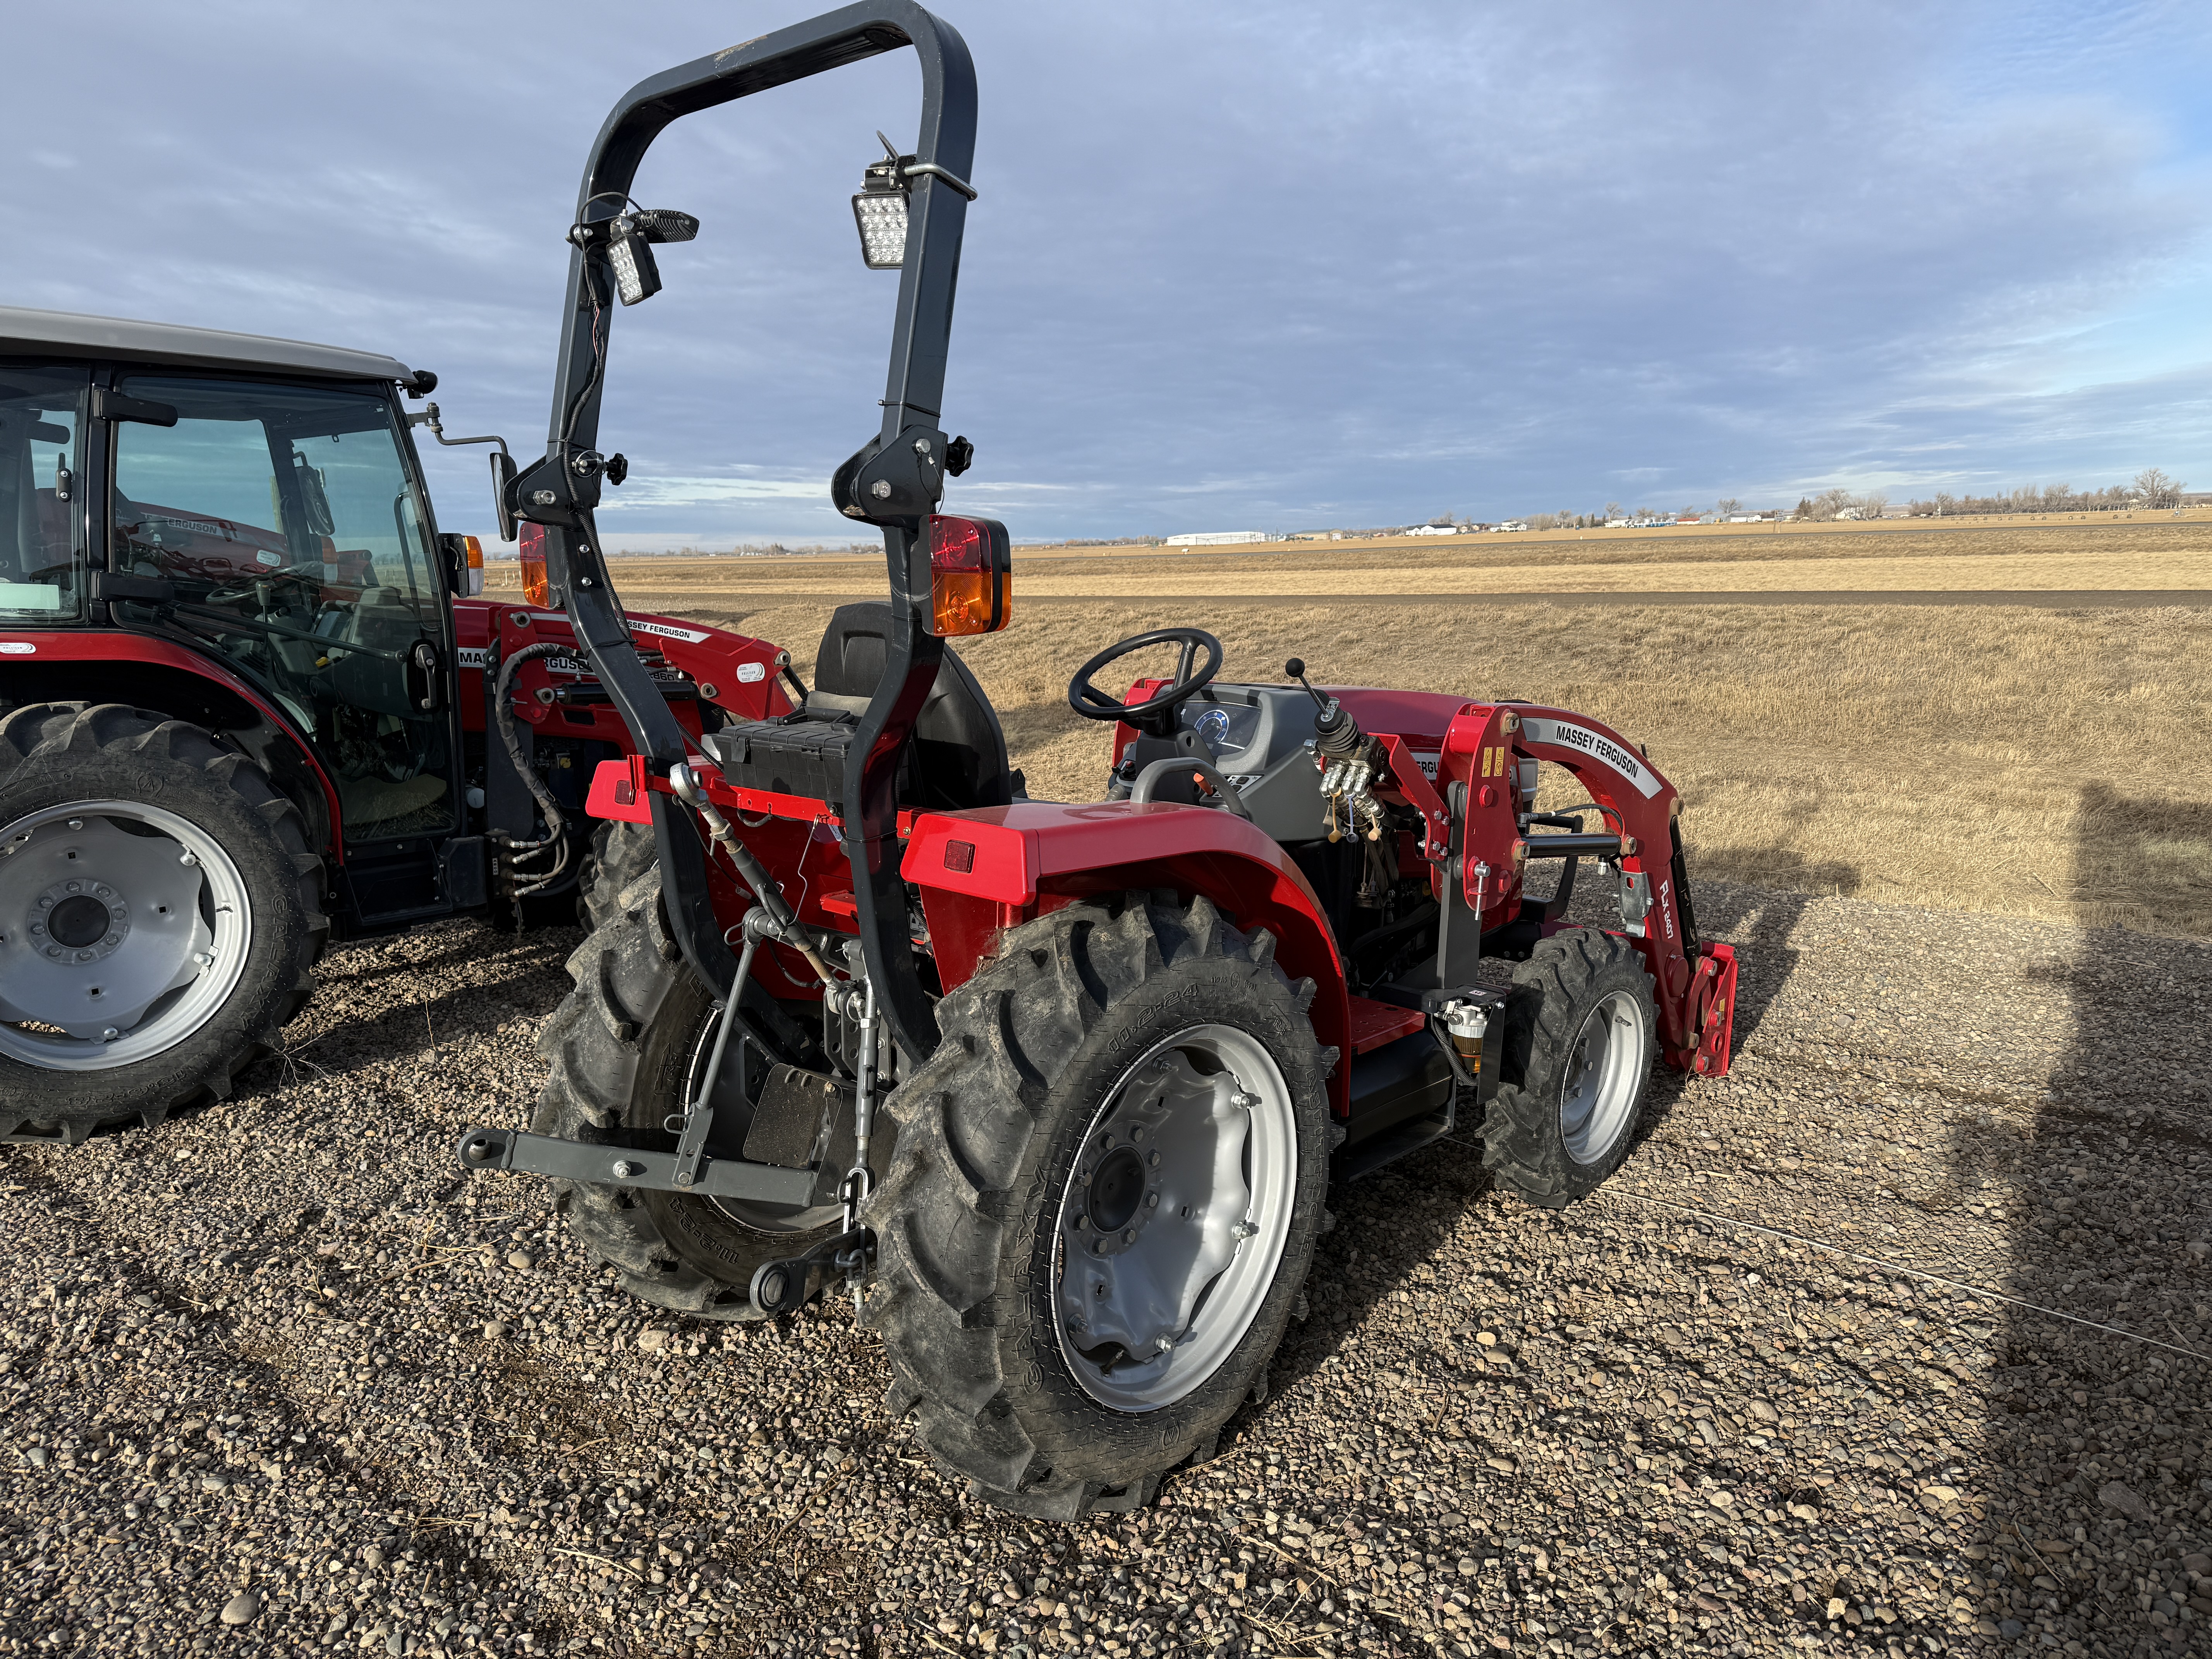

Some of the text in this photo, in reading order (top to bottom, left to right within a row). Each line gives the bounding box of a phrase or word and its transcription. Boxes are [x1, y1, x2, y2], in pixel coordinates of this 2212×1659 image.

[627, 621, 690, 638] SSEY FERGUSON
[650, 672, 675, 681] 860
[1556, 725, 1638, 778] MASSEY FERGUSON
[1660, 879, 1673, 939] FLX 2407
[239, 894, 288, 1031] GALAXY
[1108, 983, 1199, 1053] 11.2-24
[668, 1196, 739, 1264] 11.2-24
[1013, 1164, 1048, 1395] GALAXY
